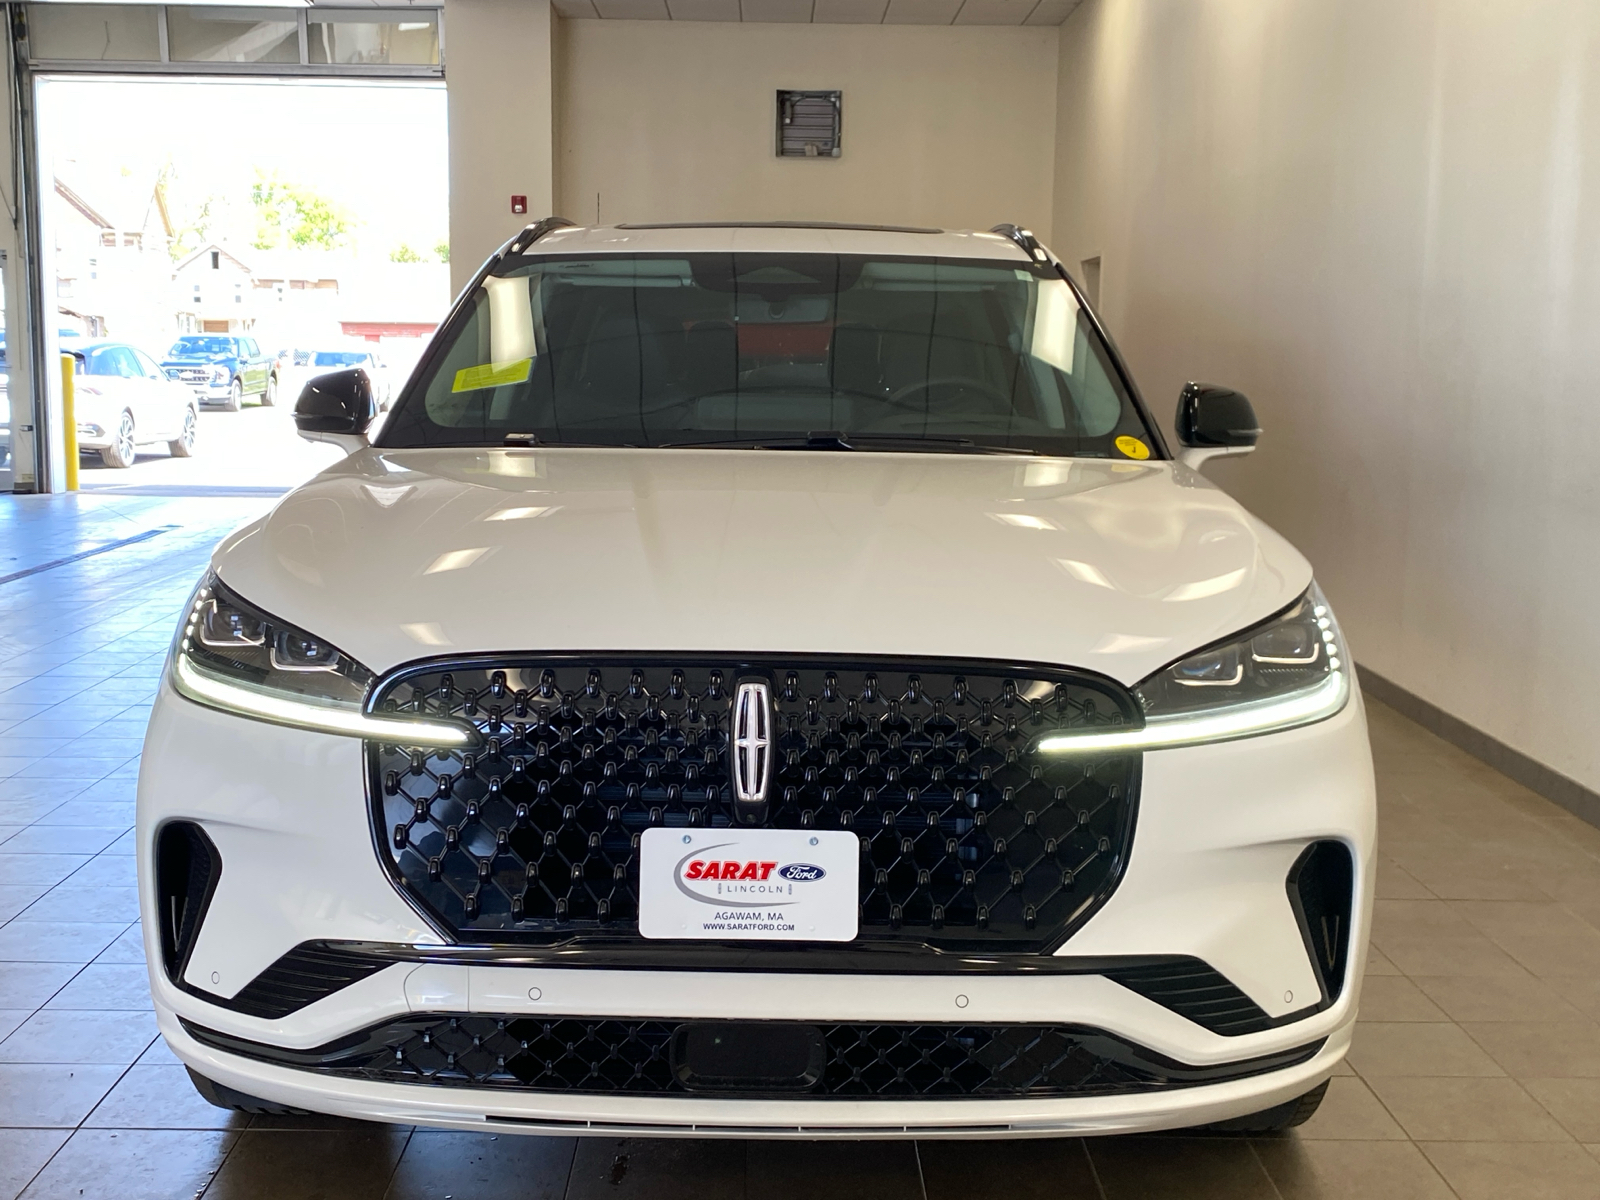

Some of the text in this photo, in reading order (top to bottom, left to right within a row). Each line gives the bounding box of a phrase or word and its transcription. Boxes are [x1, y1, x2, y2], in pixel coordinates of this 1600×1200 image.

[684, 860, 819, 882] SARAT Ford
[727, 885, 783, 894] LINCOLN
[714, 912, 784, 922] AGAWAM, MA
[703, 923, 795, 931] WWW.SARATFORD.COM
